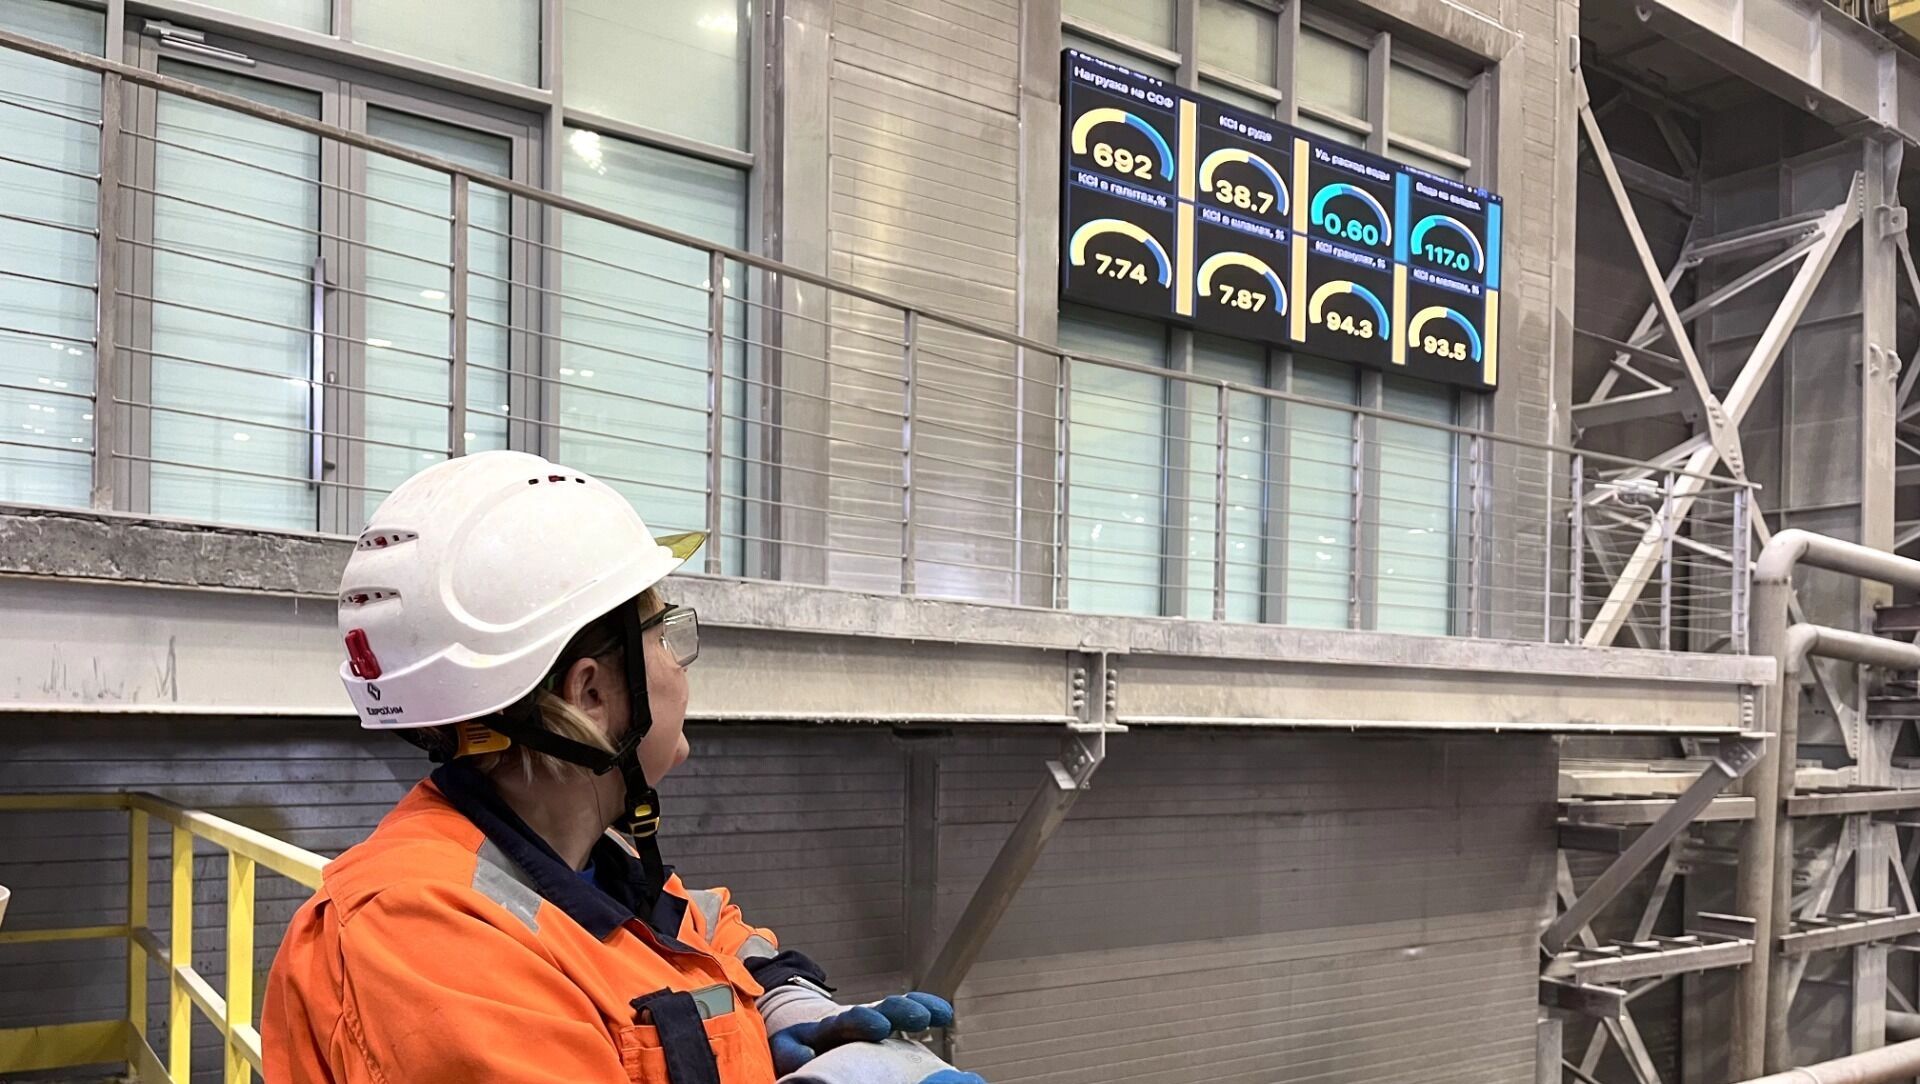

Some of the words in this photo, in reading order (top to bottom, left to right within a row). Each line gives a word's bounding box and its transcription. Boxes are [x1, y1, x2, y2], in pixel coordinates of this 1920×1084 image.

[1074, 66, 1129, 94] Нагрузка
[1130, 87, 1145, 99] на
[1093, 142, 1153, 180] 692
[1215, 179, 1274, 214] 38.7
[1324, 213, 1379, 246] 0.60
[1095, 253, 1148, 285] 7.74
[1425, 244, 1470, 272] 117.0
[1219, 284, 1267, 312] 7.87
[1326, 311, 1373, 339] 94.3
[1424, 335, 1466, 361] 93.5
